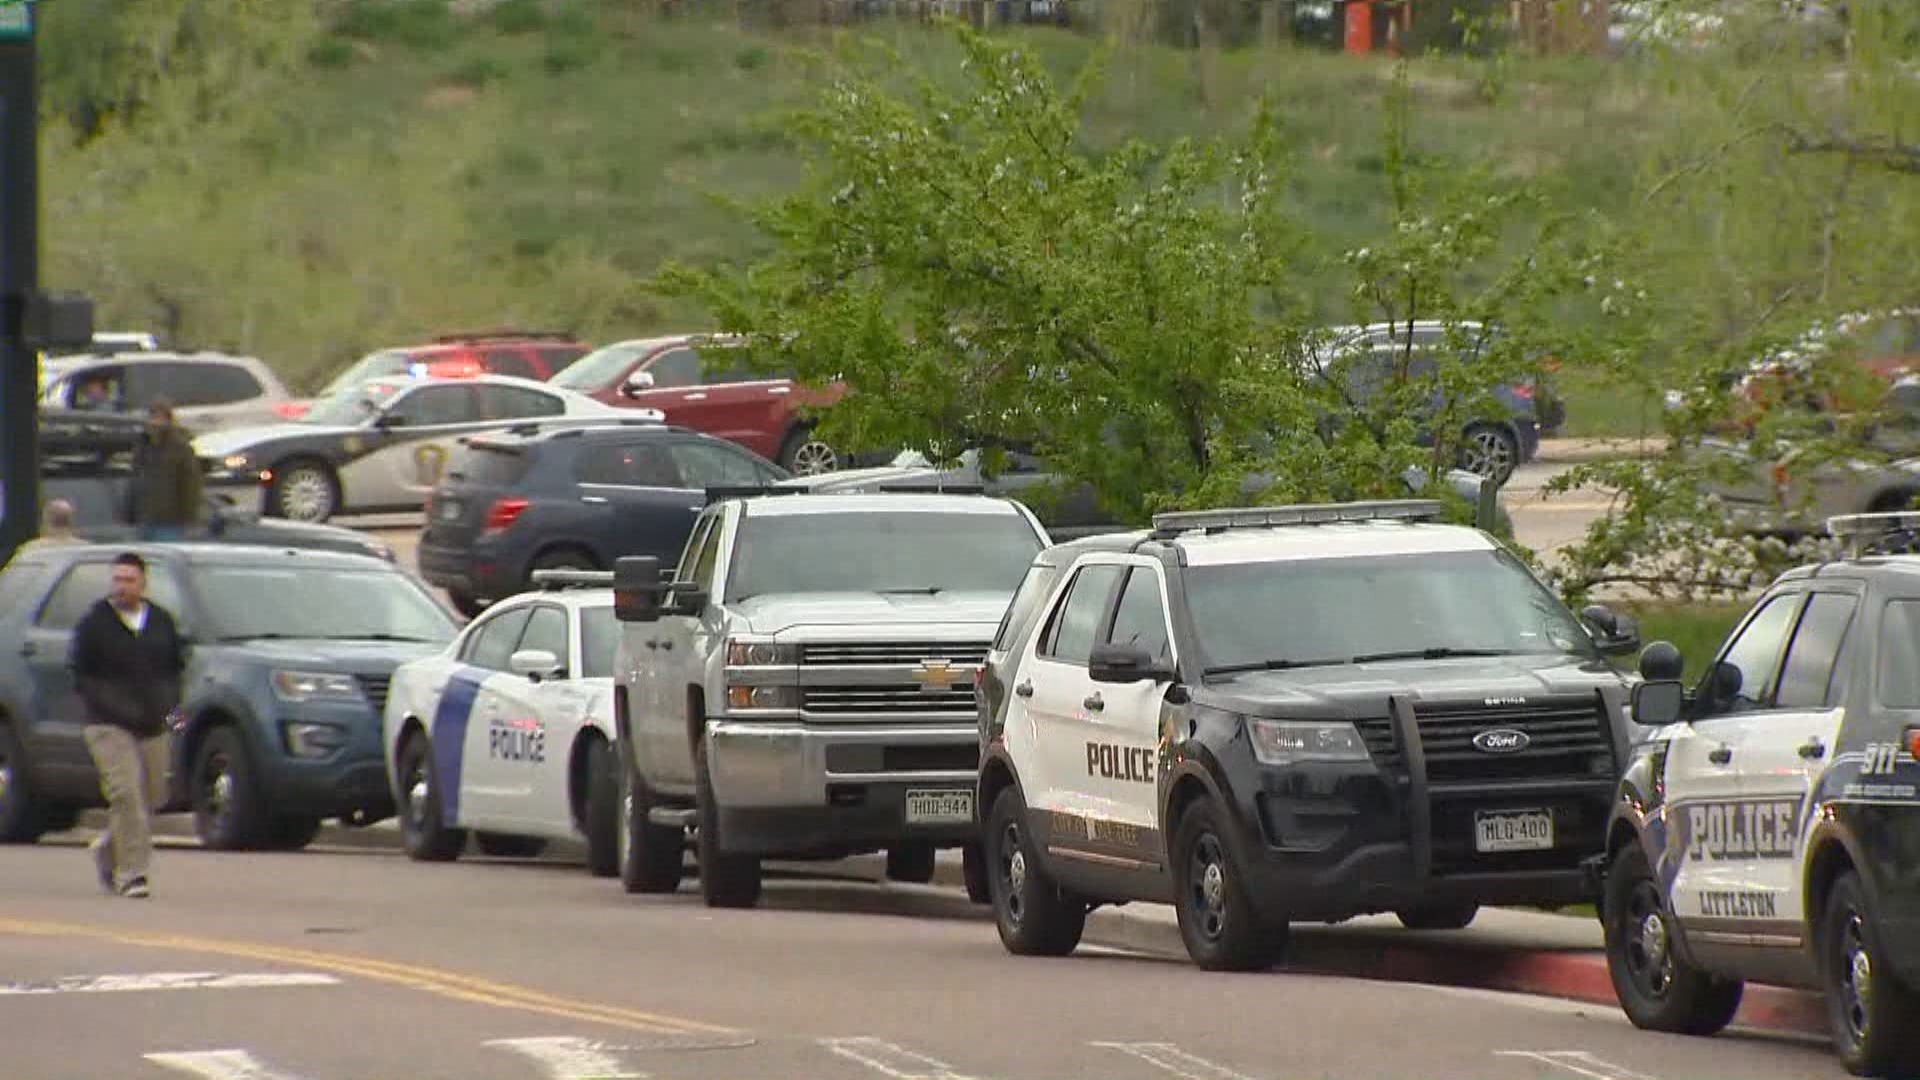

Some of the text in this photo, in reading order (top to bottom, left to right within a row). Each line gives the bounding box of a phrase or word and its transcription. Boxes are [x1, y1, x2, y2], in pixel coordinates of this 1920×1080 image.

[488, 729, 544, 763] POLICE
[1086, 742, 1154, 783] POLICE
[1861, 743, 1902, 774] 911
[1689, 802, 1795, 859] POLICE
[1699, 891, 1775, 917] LITTLETON
